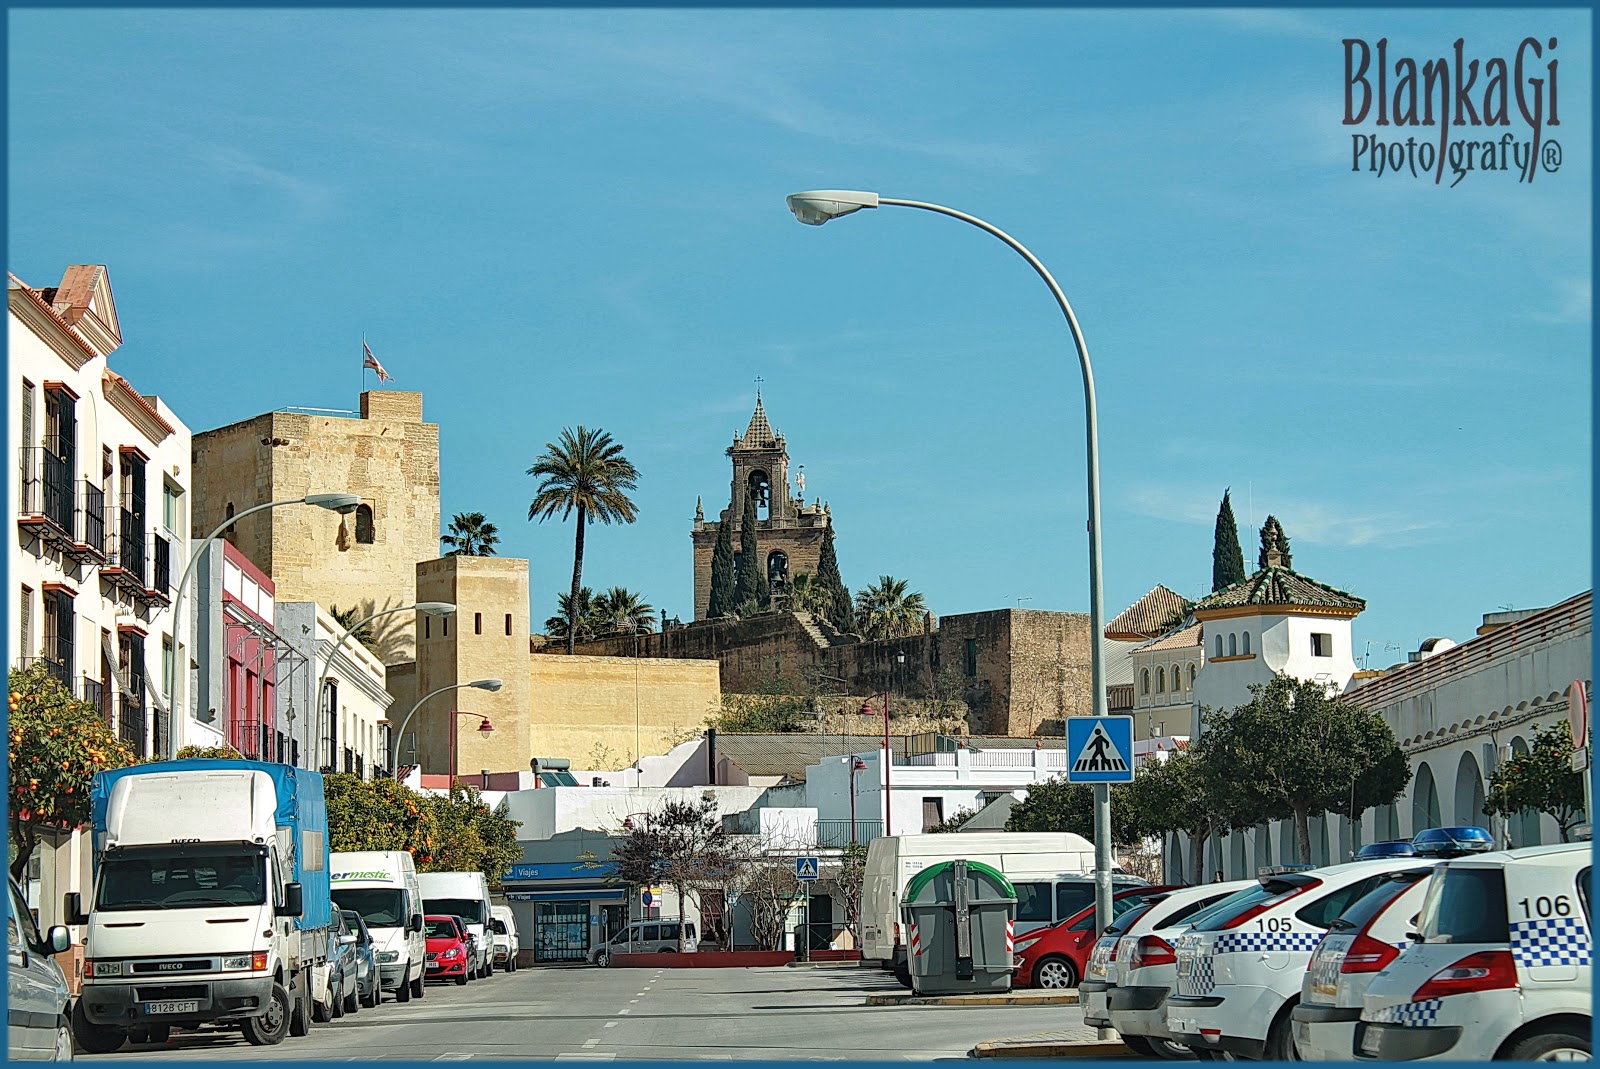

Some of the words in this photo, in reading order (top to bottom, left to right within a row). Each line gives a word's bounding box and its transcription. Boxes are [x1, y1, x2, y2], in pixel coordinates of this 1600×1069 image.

[518, 868, 538, 877] Viajes
[1518, 895, 1571, 919] 106
[1255, 917, 1292, 933] 105
[151, 1003, 175, 1012] 8128
